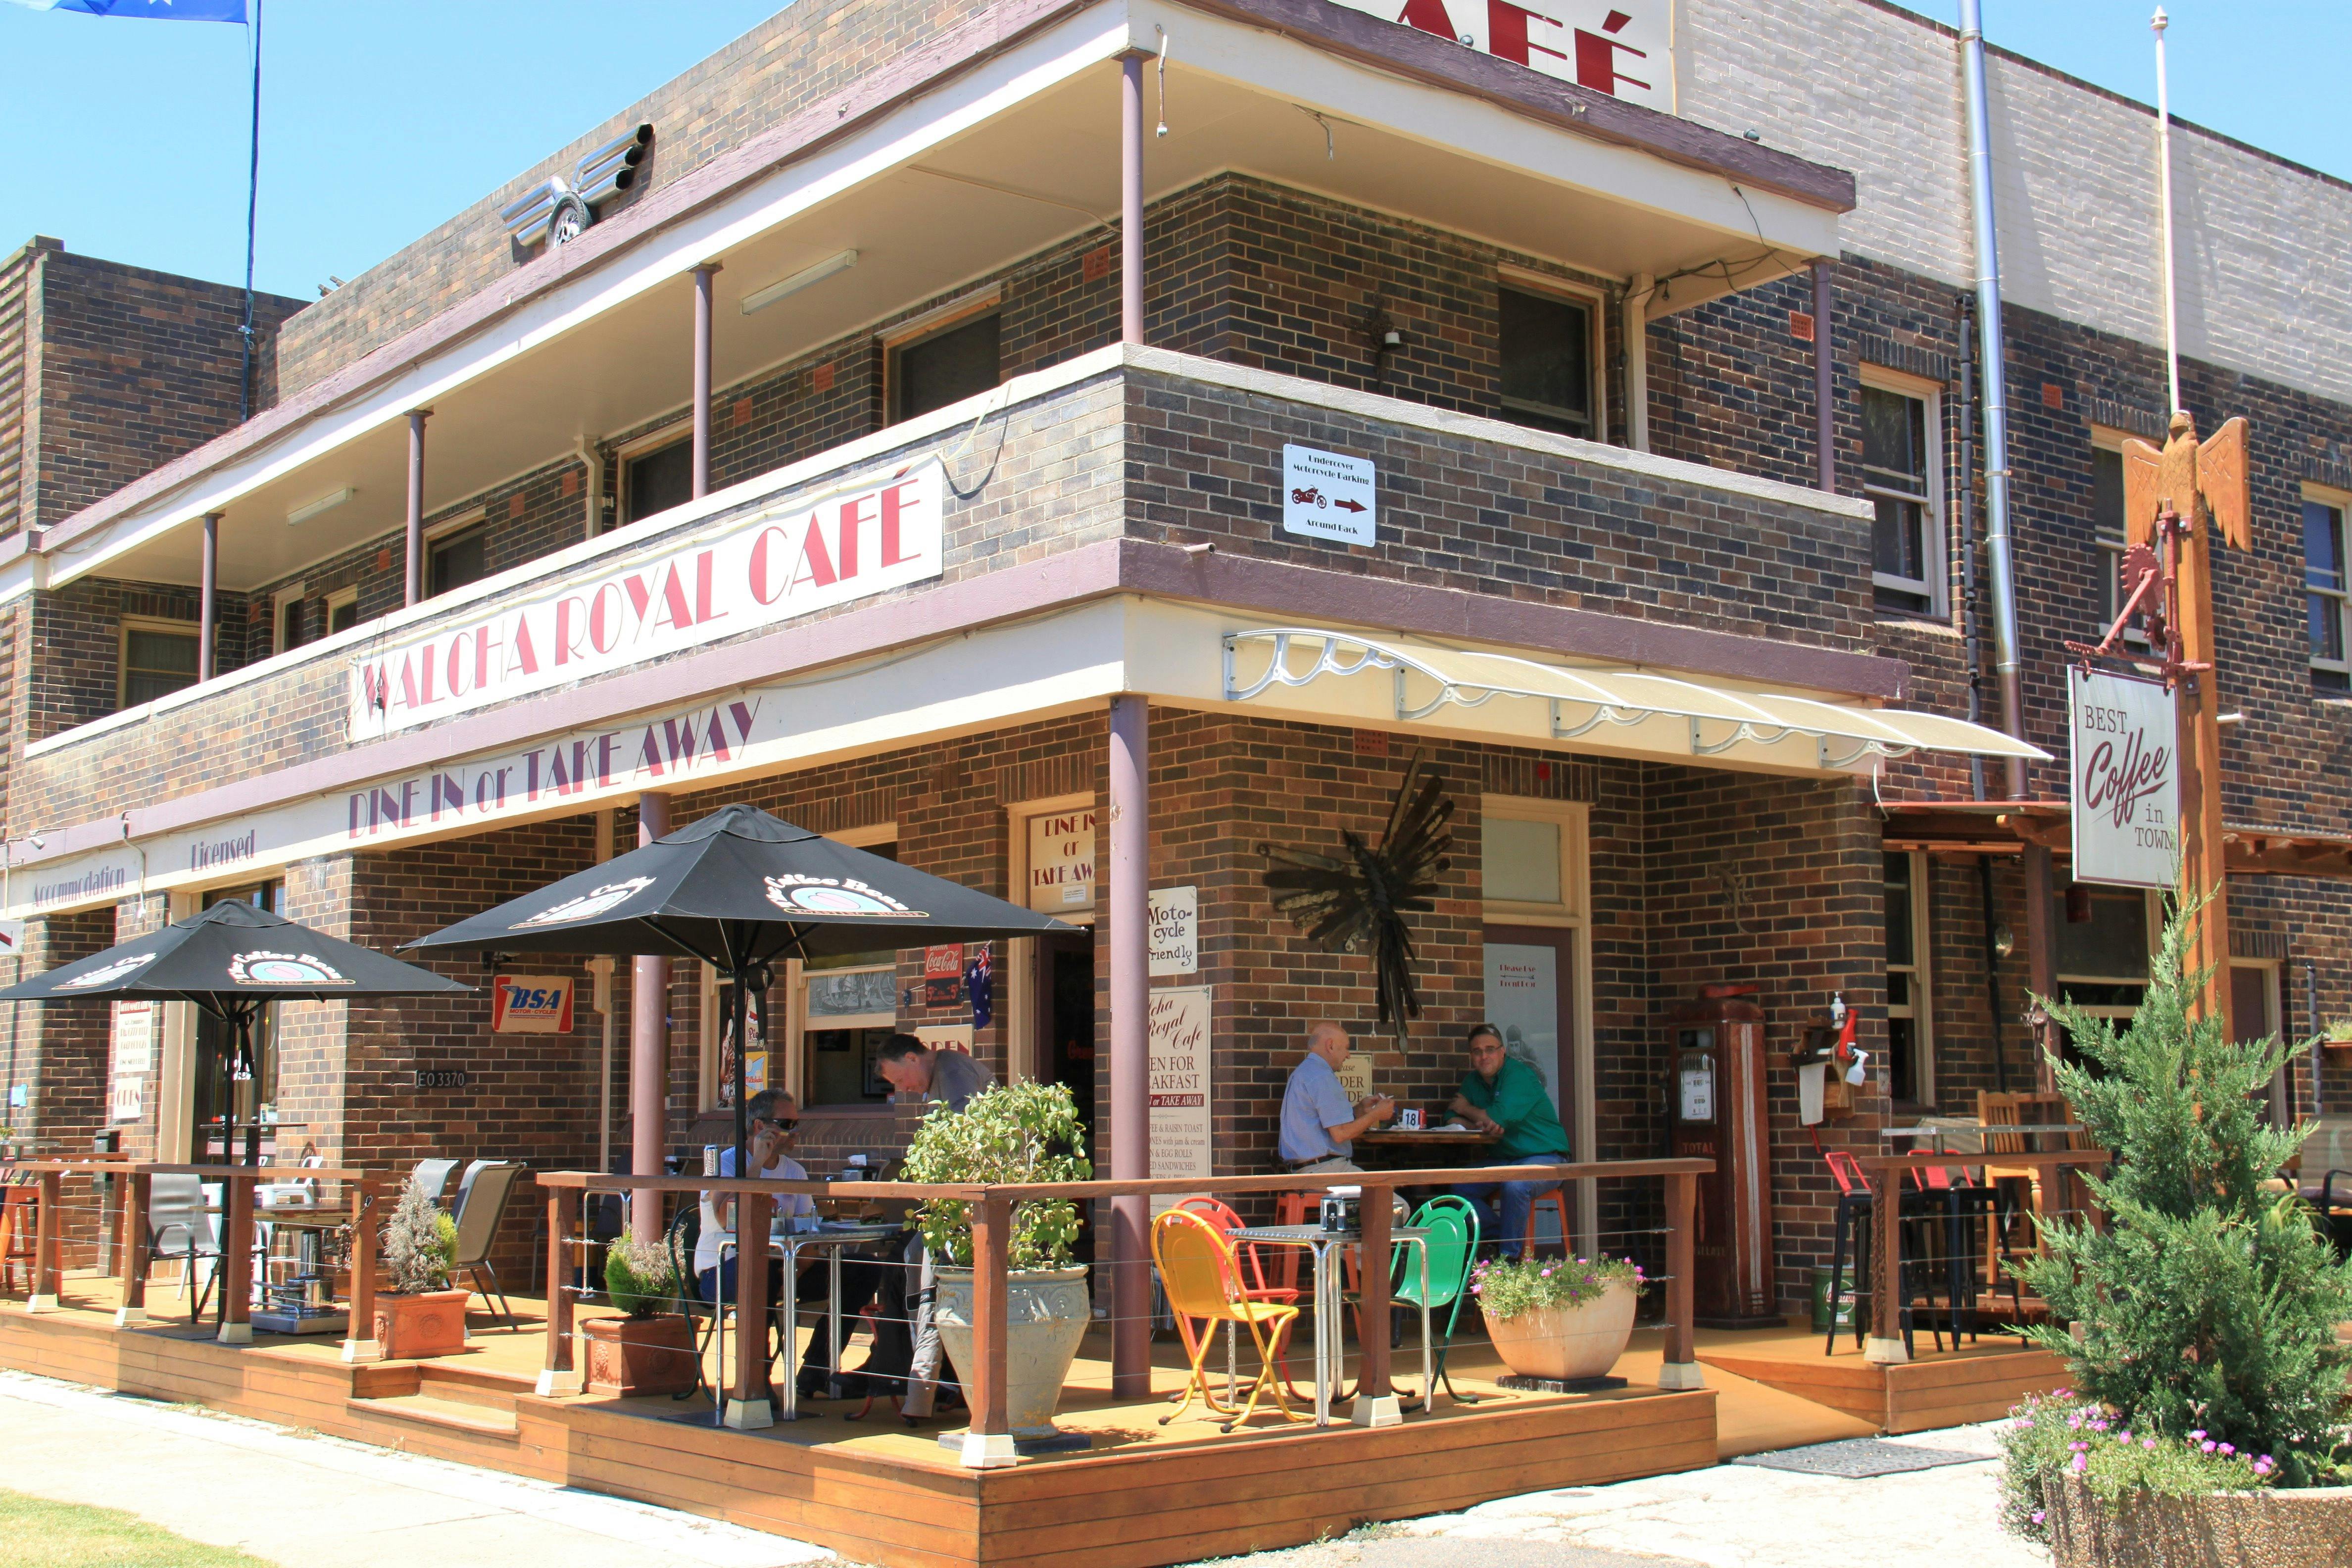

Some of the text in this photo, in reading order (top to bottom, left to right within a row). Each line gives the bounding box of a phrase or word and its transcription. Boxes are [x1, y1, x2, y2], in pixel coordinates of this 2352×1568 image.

[1308, 454, 1354, 470] Undercover
[1293, 463, 1370, 485] Motorcycle Parking
[1306, 518, 1359, 535] Around Back
[364, 466, 922, 723] WALCHA ROYAL CAFÉ
[2084, 705, 2127, 735] BEST
[349, 695, 762, 840] DINE IN or TAKE AWAY
[2085, 727, 2171, 829] Coffee
[2145, 803, 2163, 824] in
[1045, 816, 1079, 837] DINE
[2135, 827, 2173, 850] TOWN
[191, 829, 255, 872] Licensed
[1064, 841, 1079, 857] or
[764, 873, 839, 888] Coffee
[1033, 862, 1095, 886] TAKE AW
[33, 866, 125, 907] Accommodation
[1154, 921, 1185, 943] cycle
[510, 989, 562, 1009] BSA
[1149, 993, 1174, 1017] lcha
[748, 1027, 761, 1041] Pie
[1170, 1021, 1203, 1050] Cafe
[1150, 1056, 1195, 1071] EN FOR
[437, 1073, 464, 1086] 3370
[1149, 1074, 1200, 1089] AKFAST
[1339, 1076, 1364, 1088] DER
[117, 1089, 141, 1107] OPEN
[1161, 1095, 1180, 1106] TAKE
[1180, 1095, 1203, 1105] AWAY
[1165, 1124, 1182, 1132] RAISIN
[1184, 1124, 1203, 1133] TOAST
[1406, 1113, 1416, 1126] 18
[1174, 1137, 1183, 1146] jam
[1683, 1142, 1715, 1154] TOTAL
[1158, 1162, 1196, 1171] SANDWICHES
